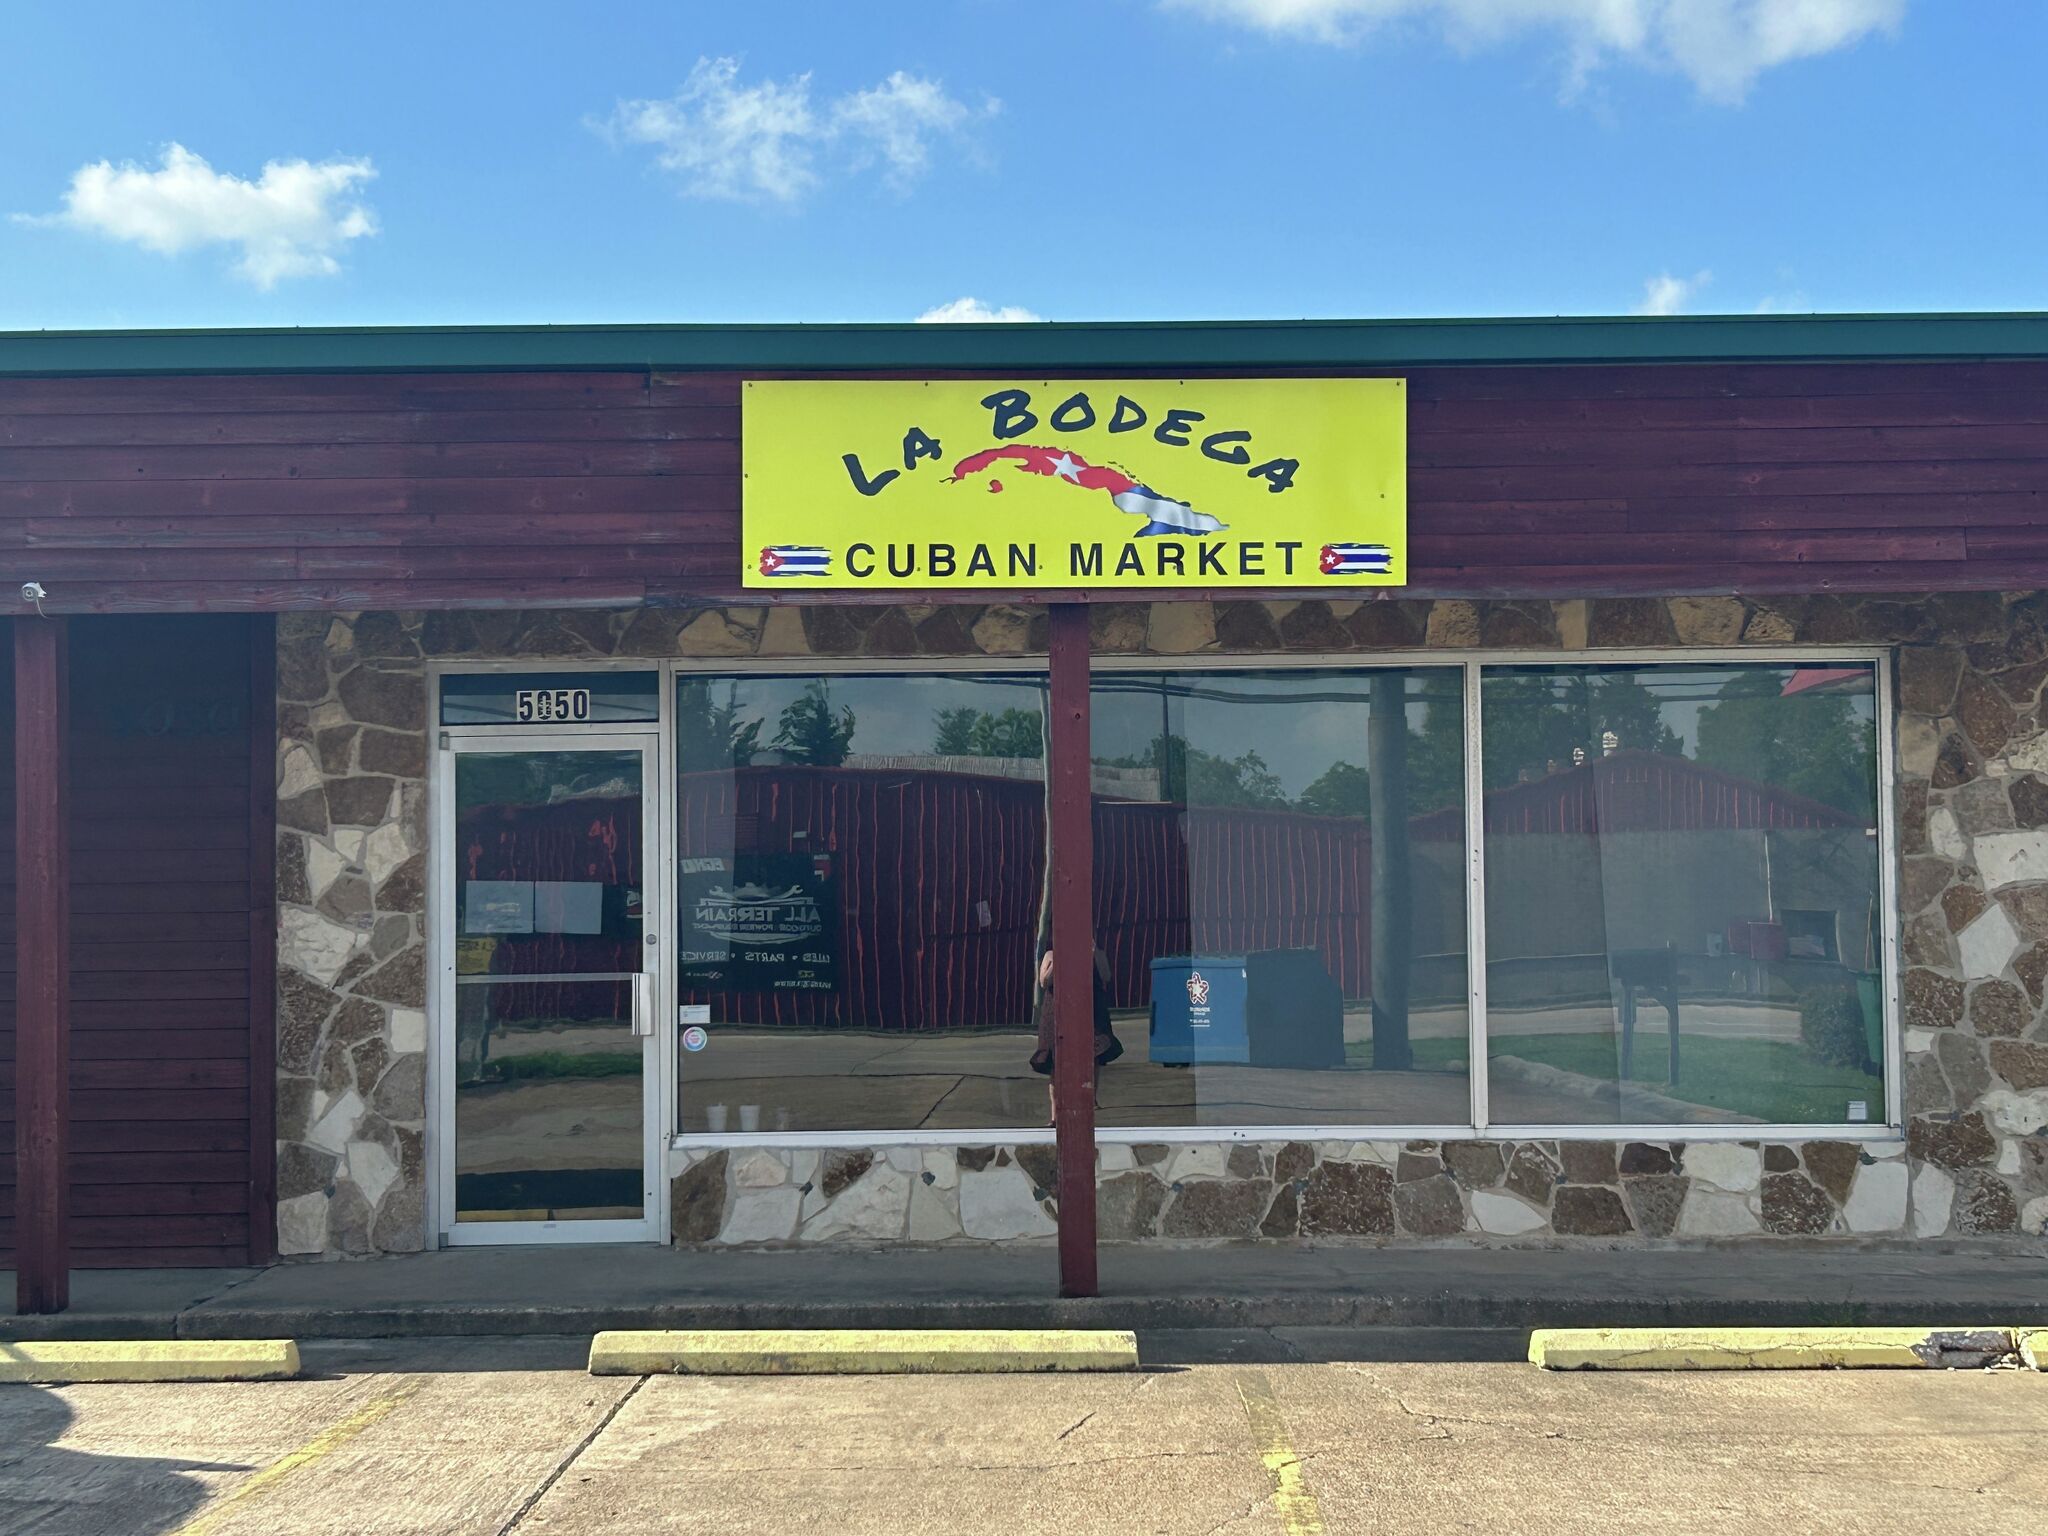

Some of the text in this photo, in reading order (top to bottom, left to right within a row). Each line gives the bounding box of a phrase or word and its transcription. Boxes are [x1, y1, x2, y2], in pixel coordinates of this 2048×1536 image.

[841, 388, 1300, 497] LA BODEGA
[845, 541, 1303, 578] CUBAN MARKET
[519, 690, 588, 721] 5050
